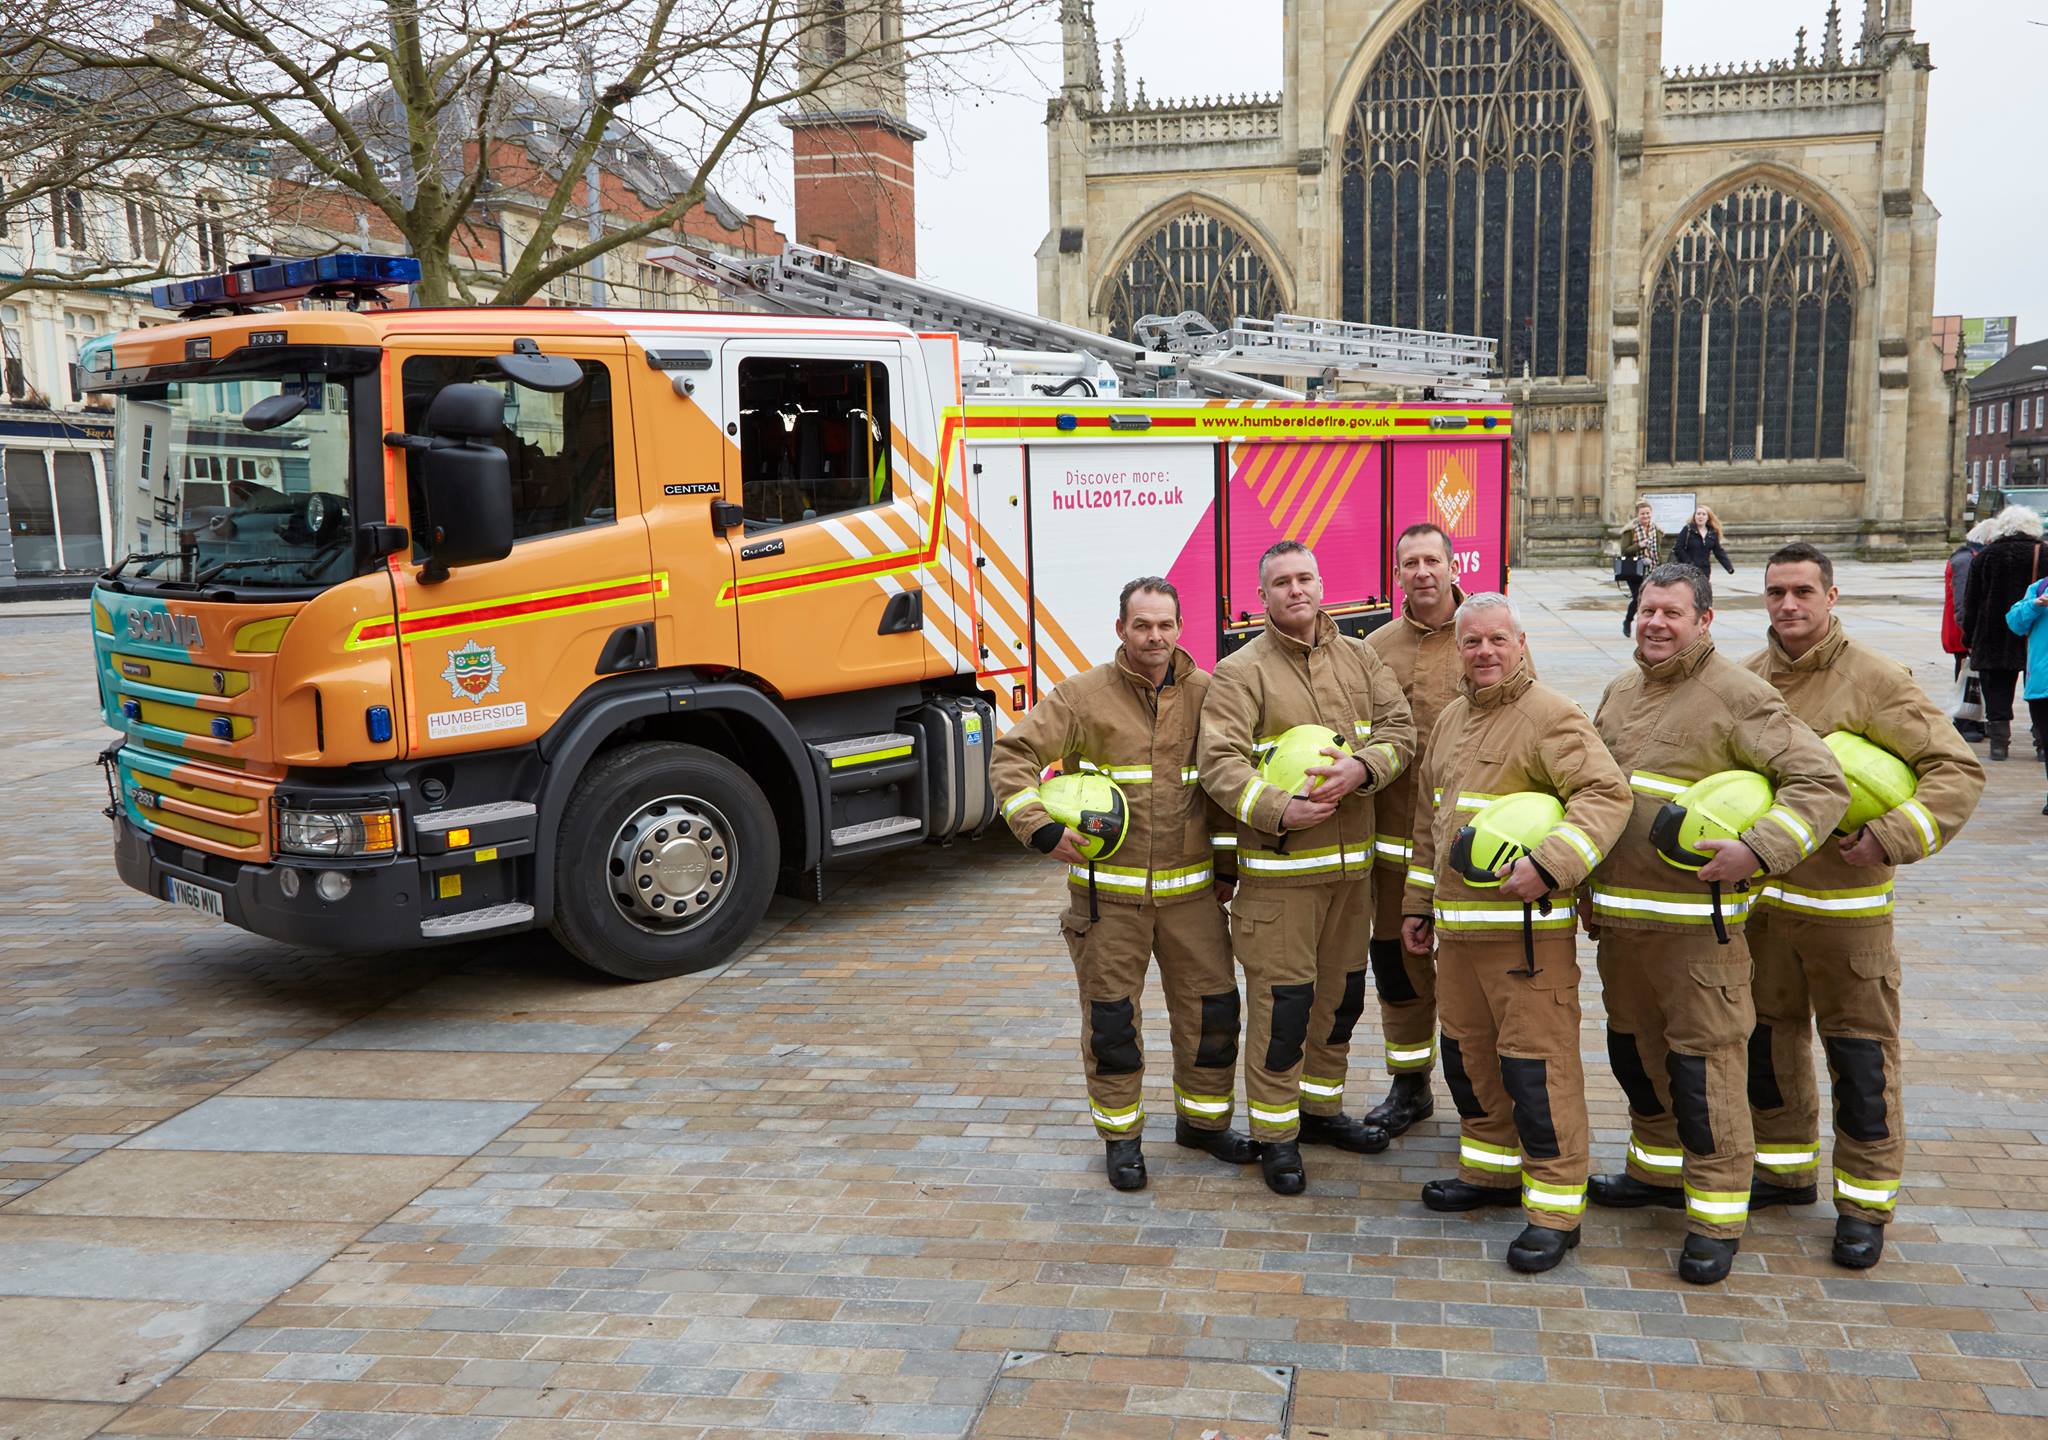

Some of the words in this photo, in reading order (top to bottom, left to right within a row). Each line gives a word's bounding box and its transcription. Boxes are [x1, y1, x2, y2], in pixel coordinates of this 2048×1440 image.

[1202, 416, 1389, 429] www.humbersidefire.gov.uk
[1066, 469, 1127, 485] Discover
[1132, 470, 1169, 483] more:
[664, 483, 720, 495] CENTRAL
[1053, 486, 1183, 510] hull2017.co.uk
[742, 541, 784, 558] CrewCab
[128, 608, 204, 649] SCANIA
[430, 705, 524, 727] HUMBERSIDE
[431, 726, 449, 737] Fire
[174, 880, 200, 908] YN66
[200, 889, 222, 917] MVL
